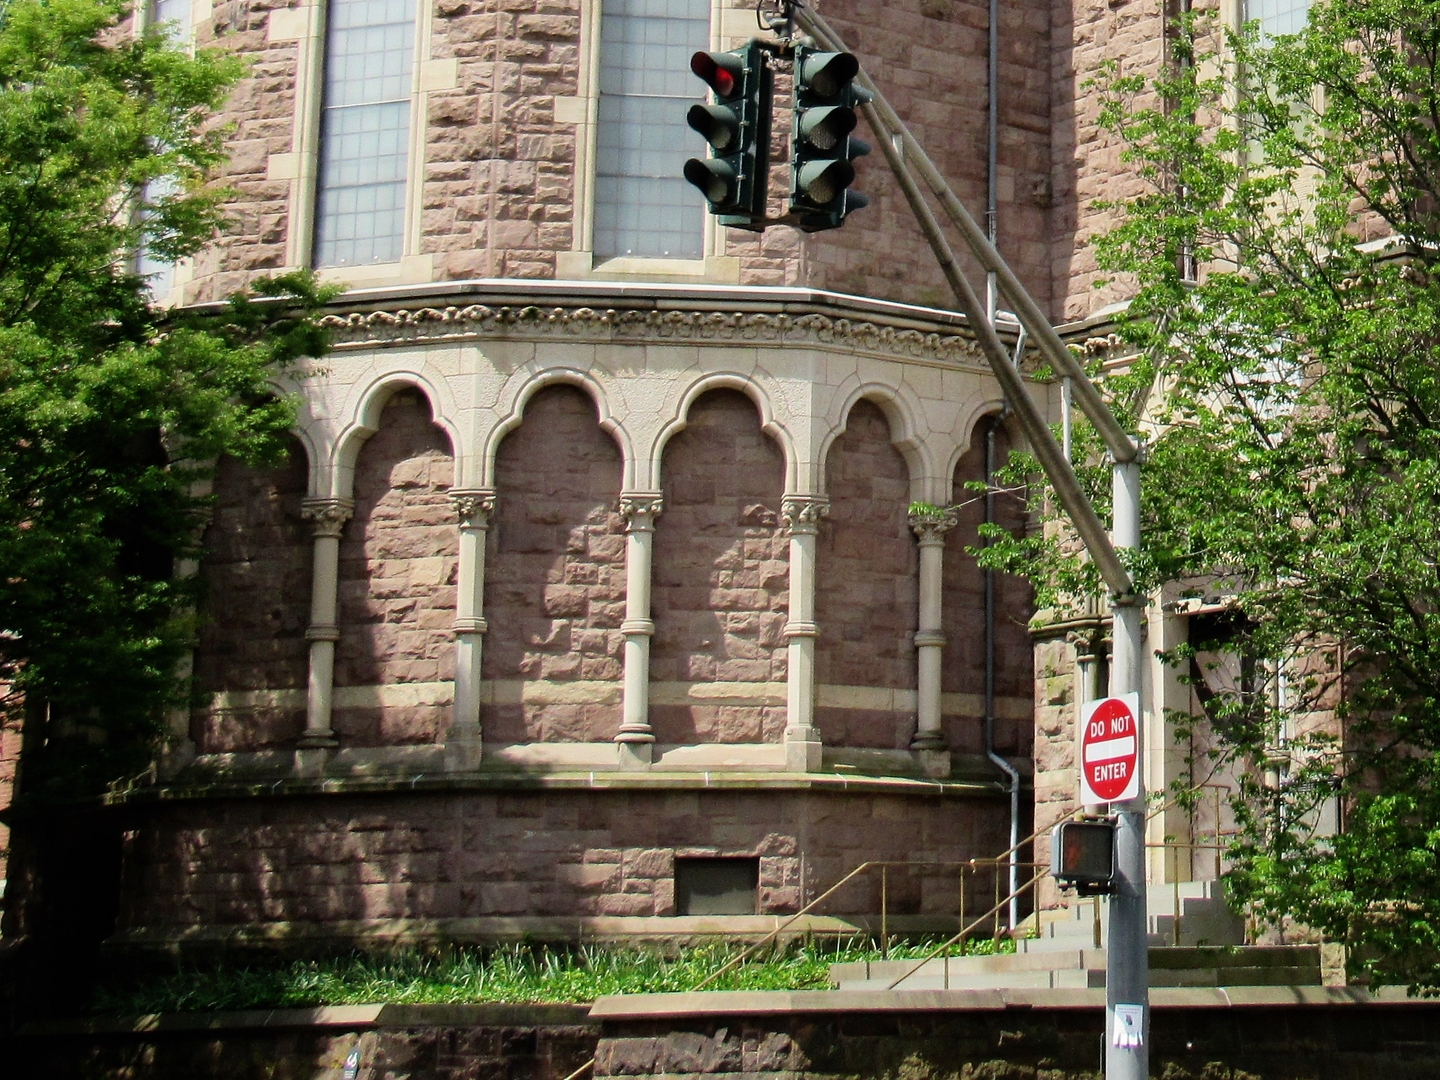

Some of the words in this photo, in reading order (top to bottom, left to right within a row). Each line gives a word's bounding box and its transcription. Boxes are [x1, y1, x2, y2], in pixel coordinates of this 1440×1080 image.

[1091, 721, 1105, 738] DO
[1111, 716, 1130, 734] NOT
[1094, 762, 1126, 782] ENTER
